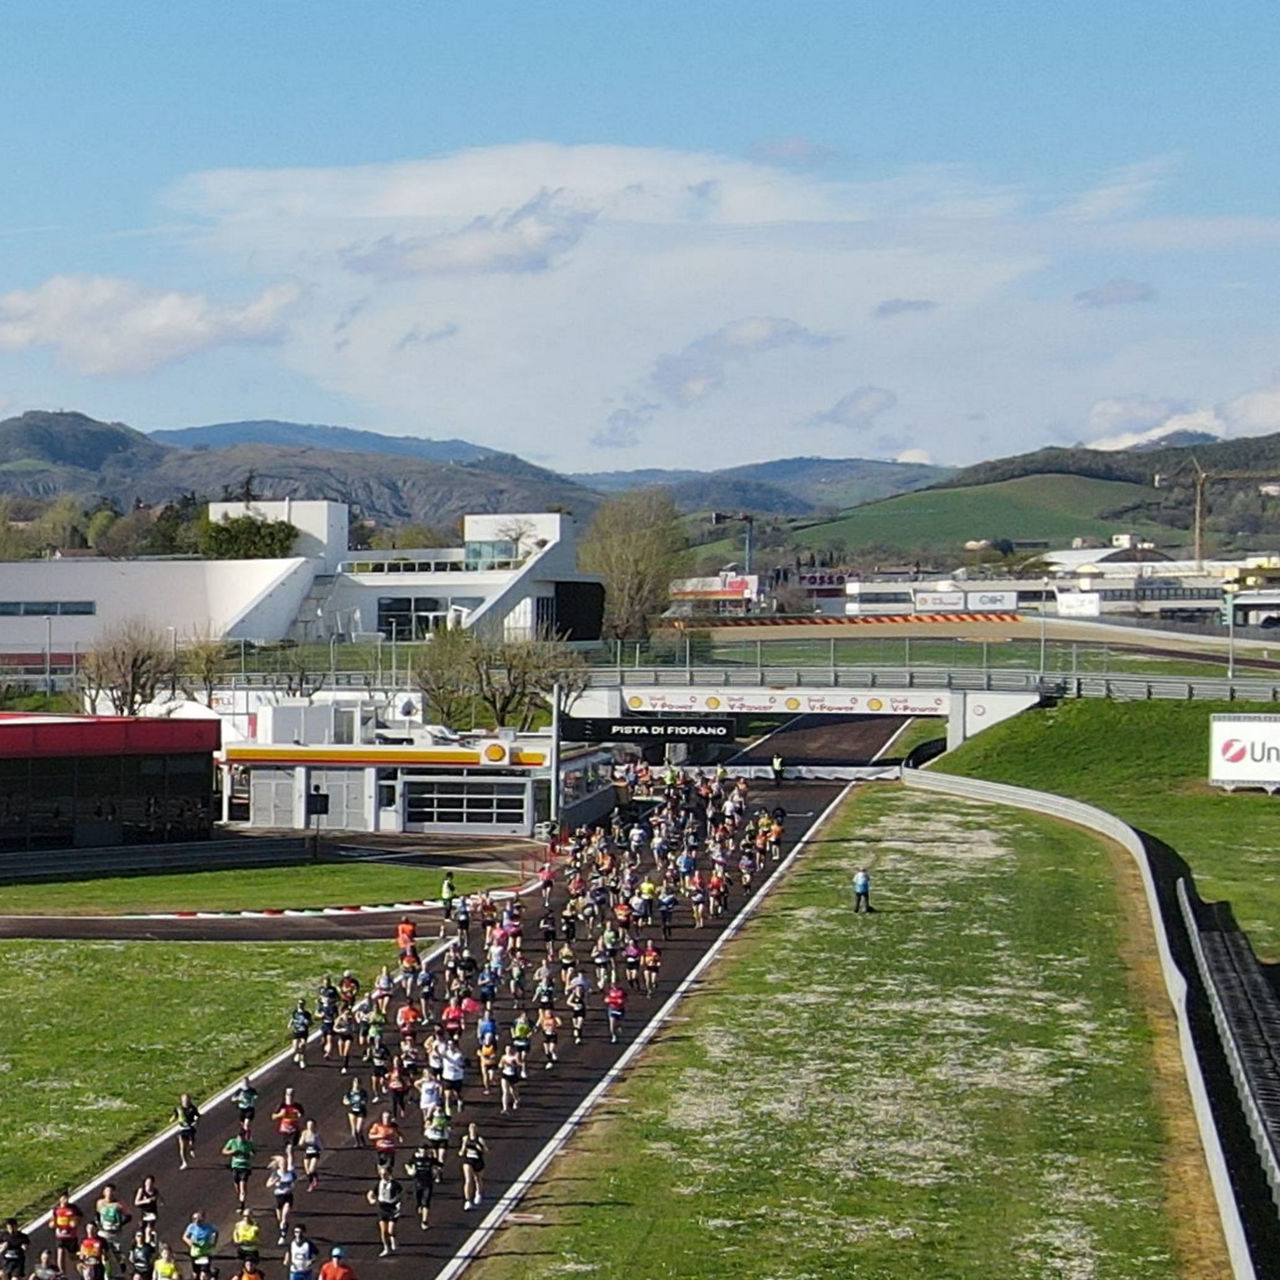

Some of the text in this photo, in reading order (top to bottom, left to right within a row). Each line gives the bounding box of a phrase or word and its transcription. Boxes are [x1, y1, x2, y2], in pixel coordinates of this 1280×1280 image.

[611, 725, 727, 736] PISTA DI FIORANO
[1250, 741, 1280, 763] Un
